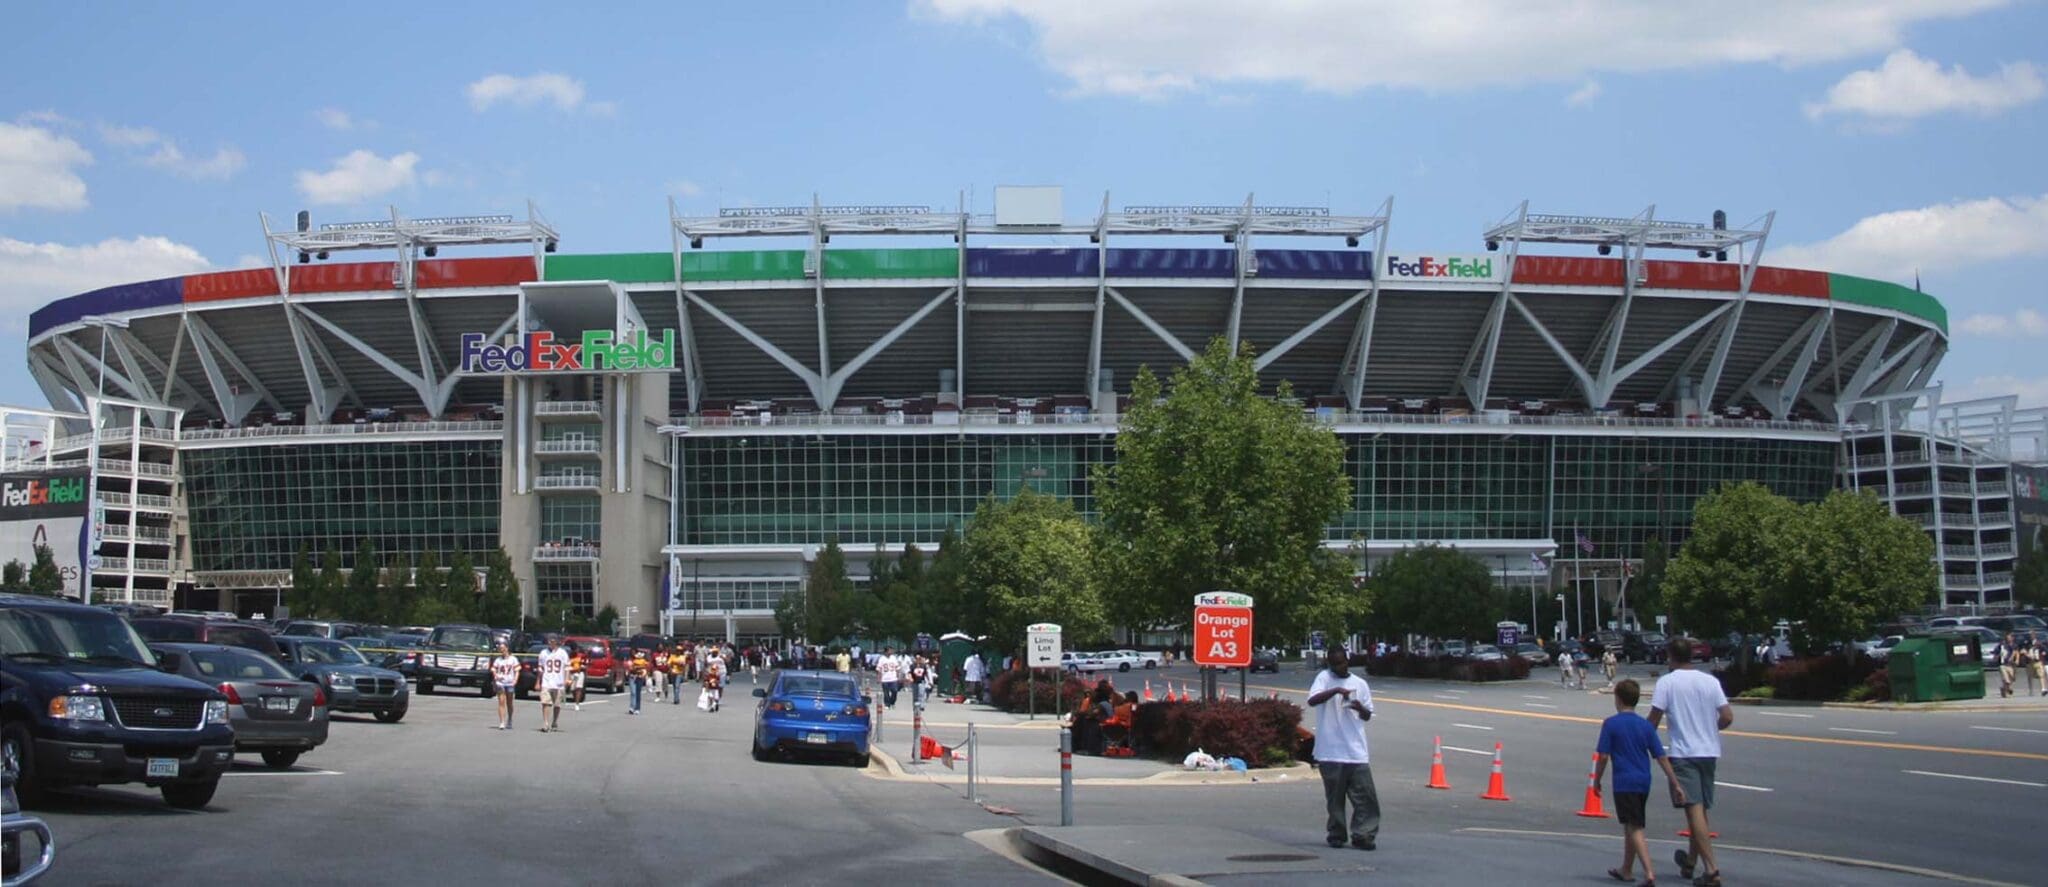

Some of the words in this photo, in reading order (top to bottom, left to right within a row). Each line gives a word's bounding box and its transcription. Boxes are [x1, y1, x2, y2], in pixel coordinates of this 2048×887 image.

[1387, 256, 1492, 278] FedExField
[460, 328, 675, 373] FedExField
[2, 477, 84, 507] FedExField
[1198, 612, 1249, 628] Orange
[1211, 626, 1235, 638] Lot
[1208, 641, 1238, 658] A3
[546, 660, 562, 673] 99
